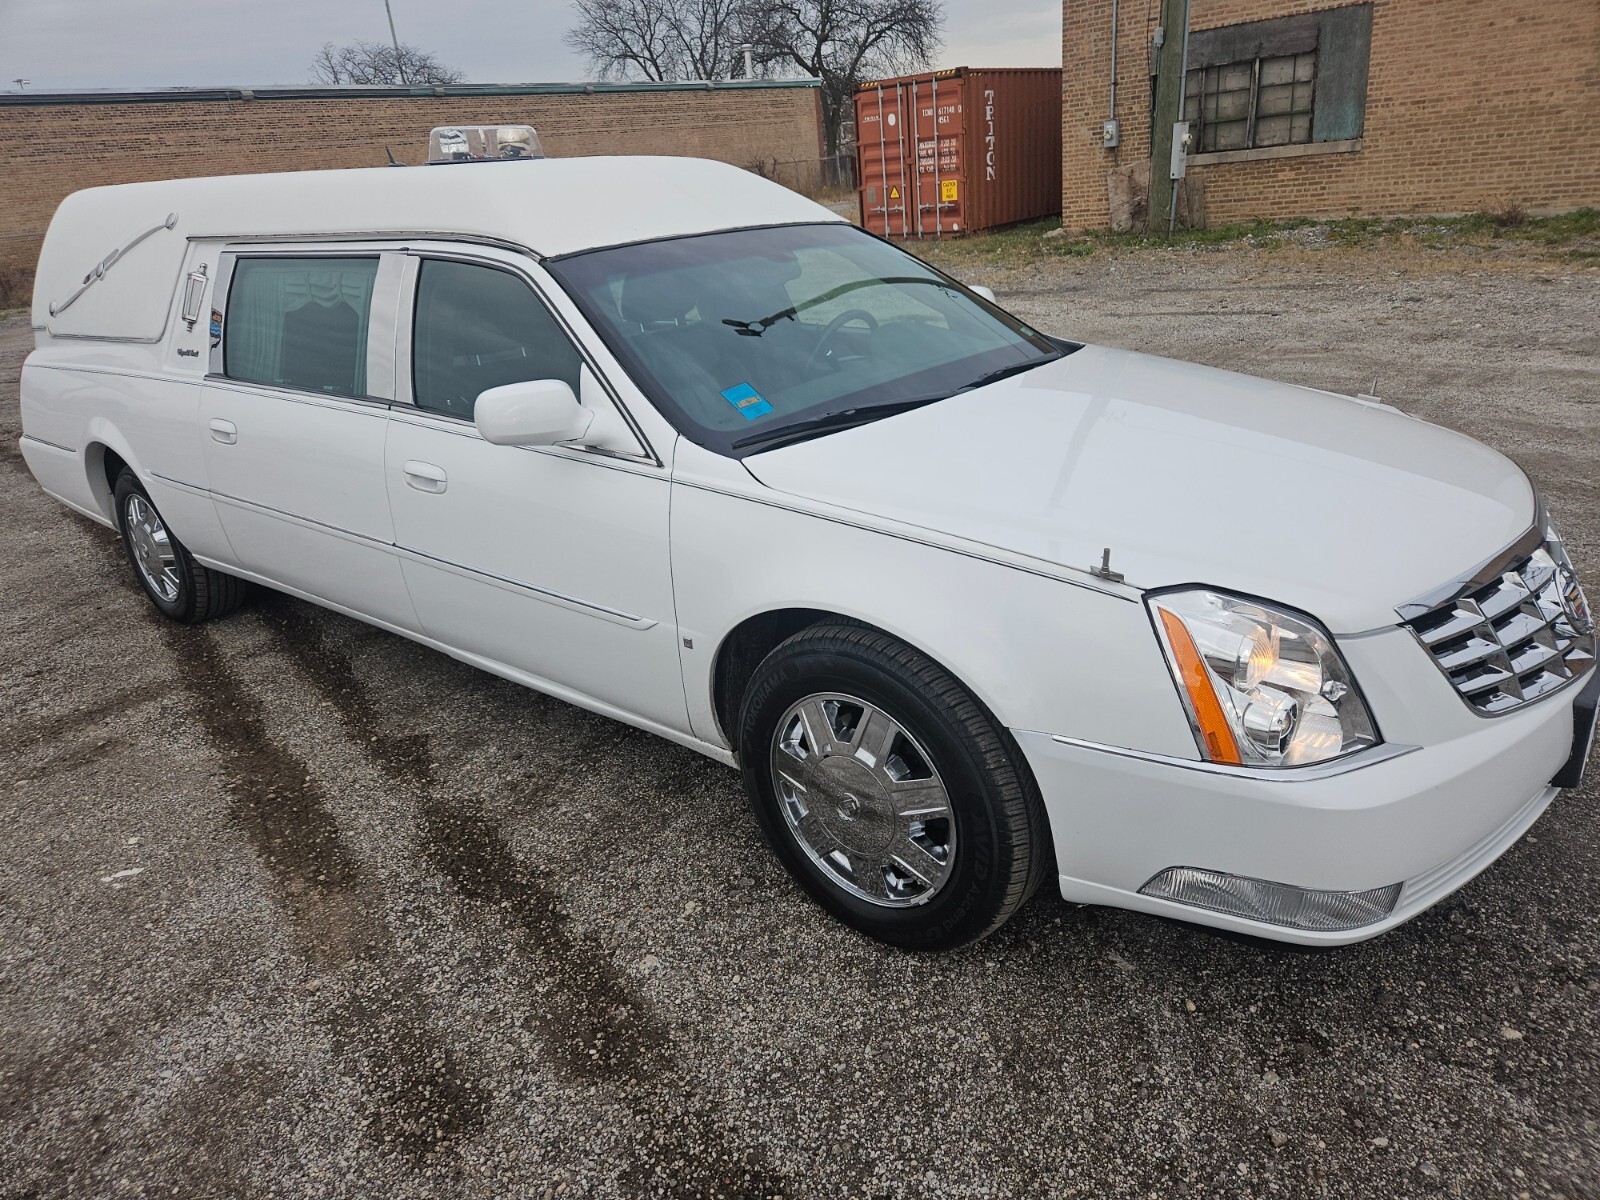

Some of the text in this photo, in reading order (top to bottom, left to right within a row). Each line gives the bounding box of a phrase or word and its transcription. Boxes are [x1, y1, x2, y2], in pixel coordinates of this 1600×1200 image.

[984, 89, 995, 181] TRITON
[744, 669, 790, 733] YOKOHAMA
[941, 879, 982, 933] Ascend
